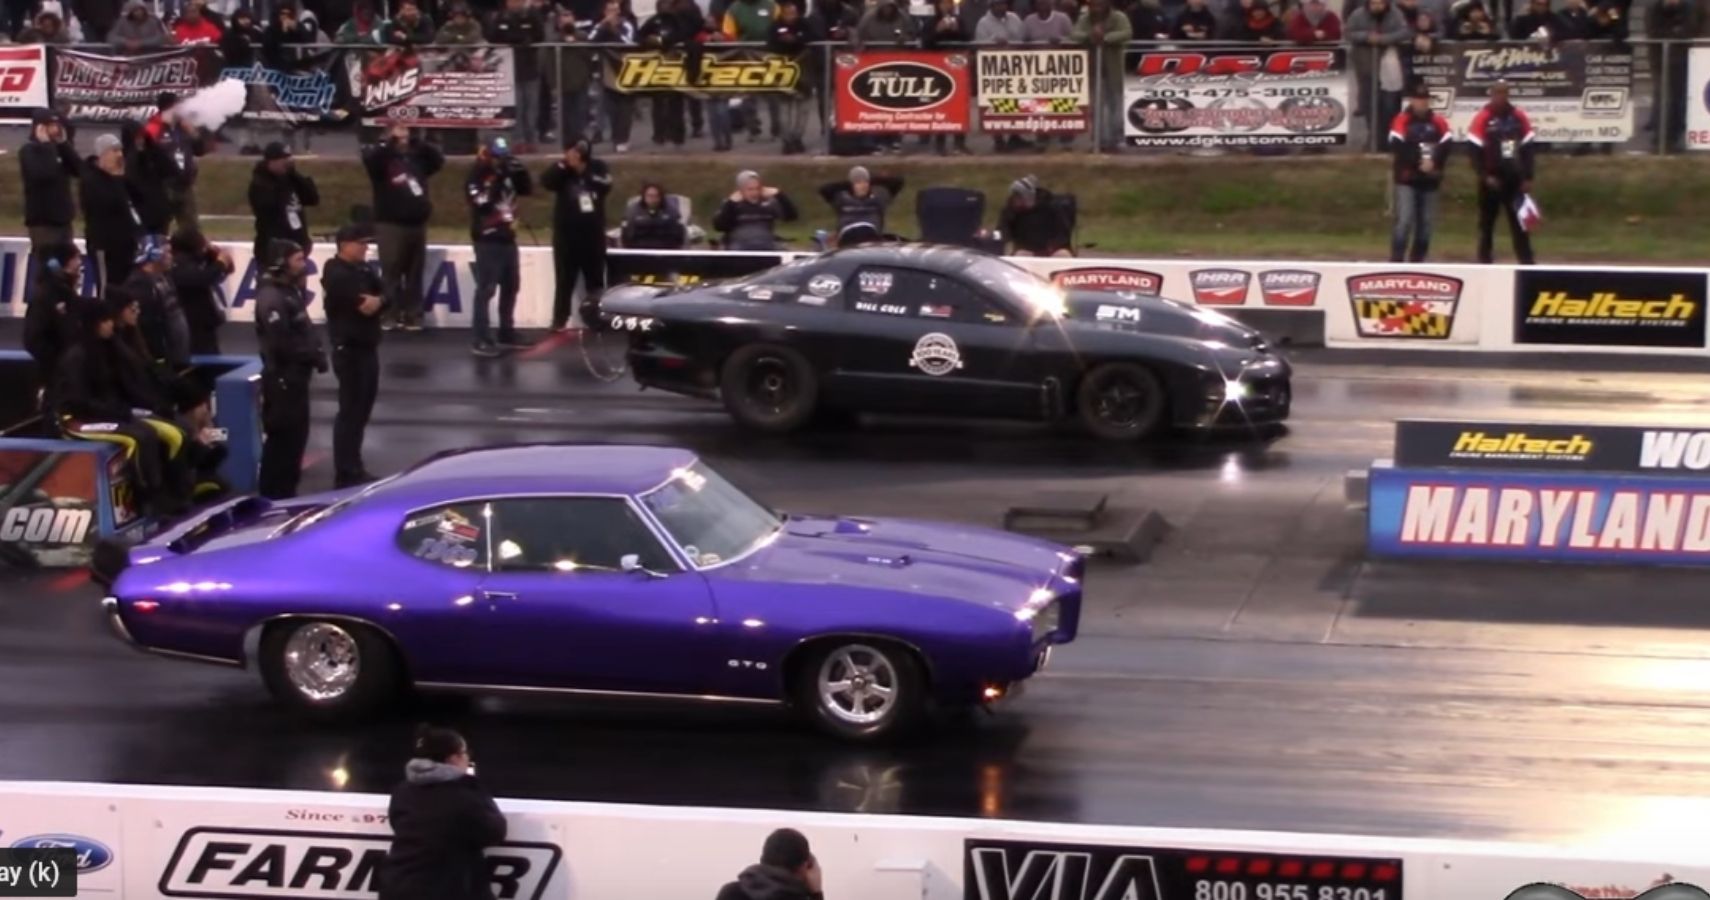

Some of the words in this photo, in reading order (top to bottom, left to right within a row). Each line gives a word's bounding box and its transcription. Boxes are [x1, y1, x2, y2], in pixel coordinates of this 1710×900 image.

[619, 56, 797, 89] Hatech
[982, 55, 1083, 76] MARYLAND
[868, 77, 940, 97] TULL
[982, 78, 1013, 94] PIPE
[1018, 79, 1027, 94] &
[1032, 78, 1083, 95] SUPPLY
[1144, 87, 1329, 99] 301-475-3808
[983, 117, 1085, 132] www.mdpipe.com
[1598, 127, 1621, 137] MD
[1135, 134, 1337, 146] www.dgkustom.com
[1063, 274, 1151, 288] MARYLAND
[1359, 279, 1451, 293] MARYLAND
[1529, 291, 1696, 318] Haltech
[1453, 432, 1593, 455] Haltech
[1401, 484, 1710, 553] MARYLAND
[727, 658, 768, 670] GTO
[285, 809, 345, 822] Since
[35, 840, 92, 867] Fd
[1195, 880, 1247, 900] 800
[1255, 883, 1309, 900] 955
